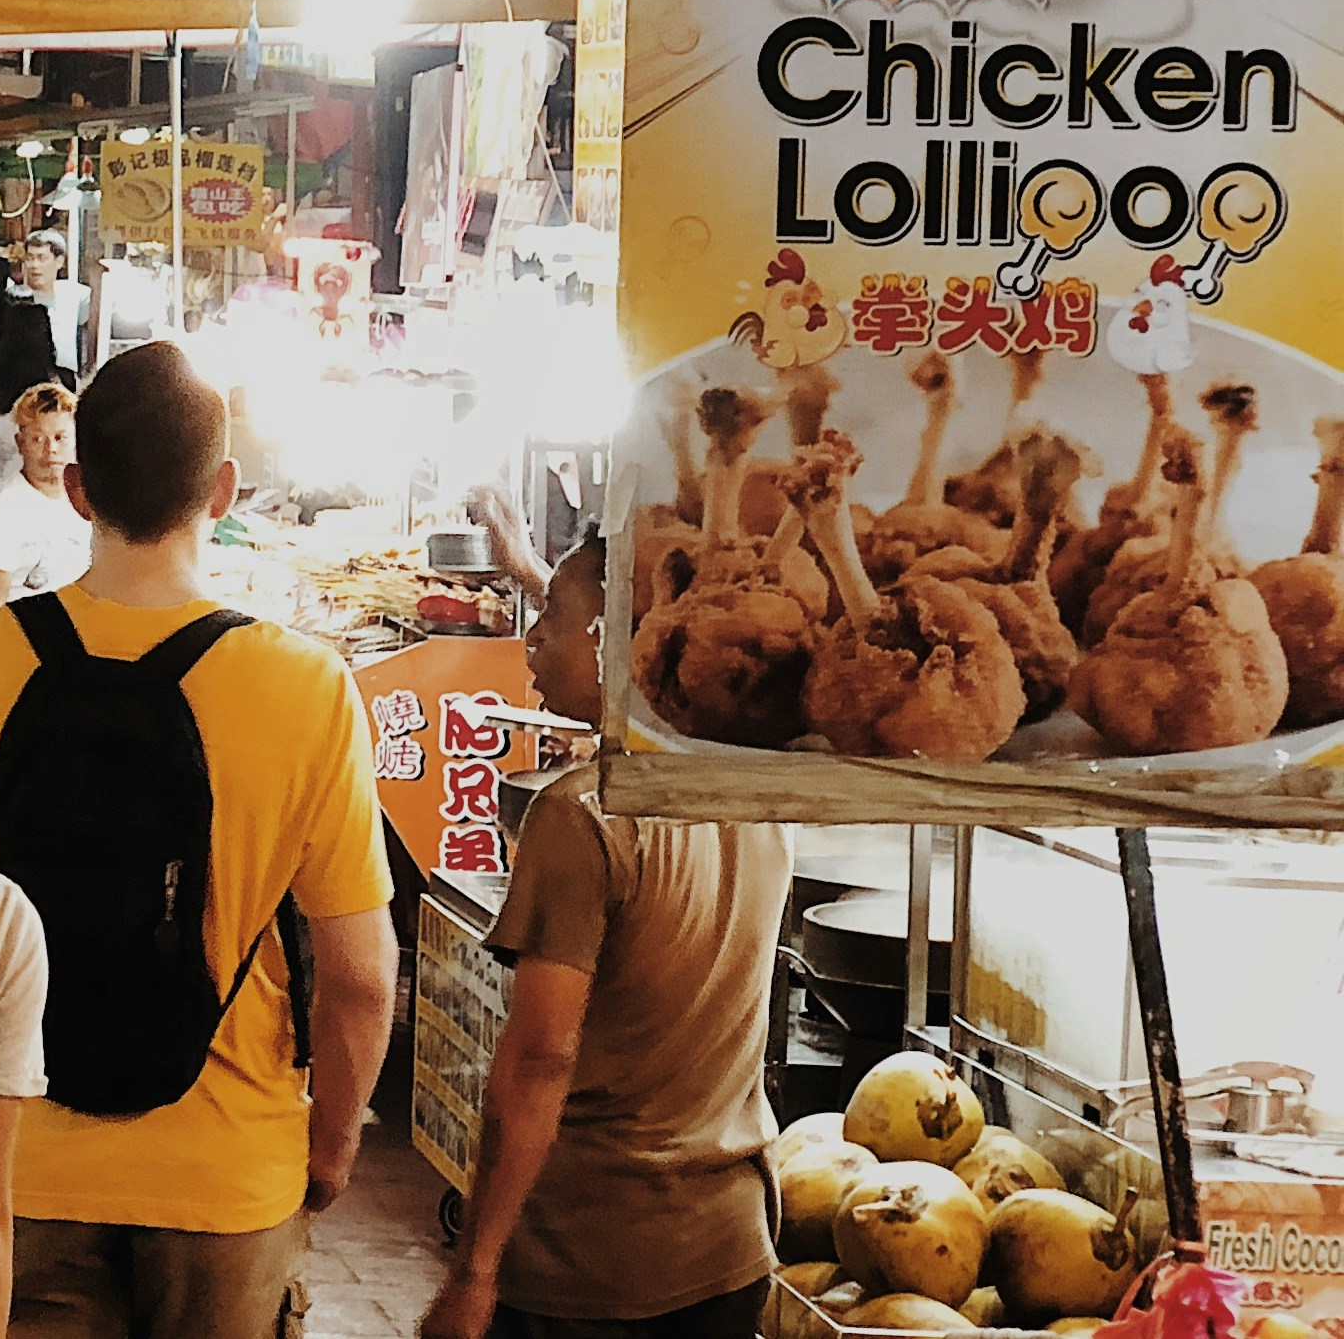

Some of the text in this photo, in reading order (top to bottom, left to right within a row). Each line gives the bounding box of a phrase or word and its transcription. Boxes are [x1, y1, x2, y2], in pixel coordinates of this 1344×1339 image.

[757, 16, 1298, 132] Chicken
[775, 137, 1288, 305] Lollipop
[851, 271, 1099, 358] 拳头鸡
[1206, 1221, 1277, 1272] Fresh
